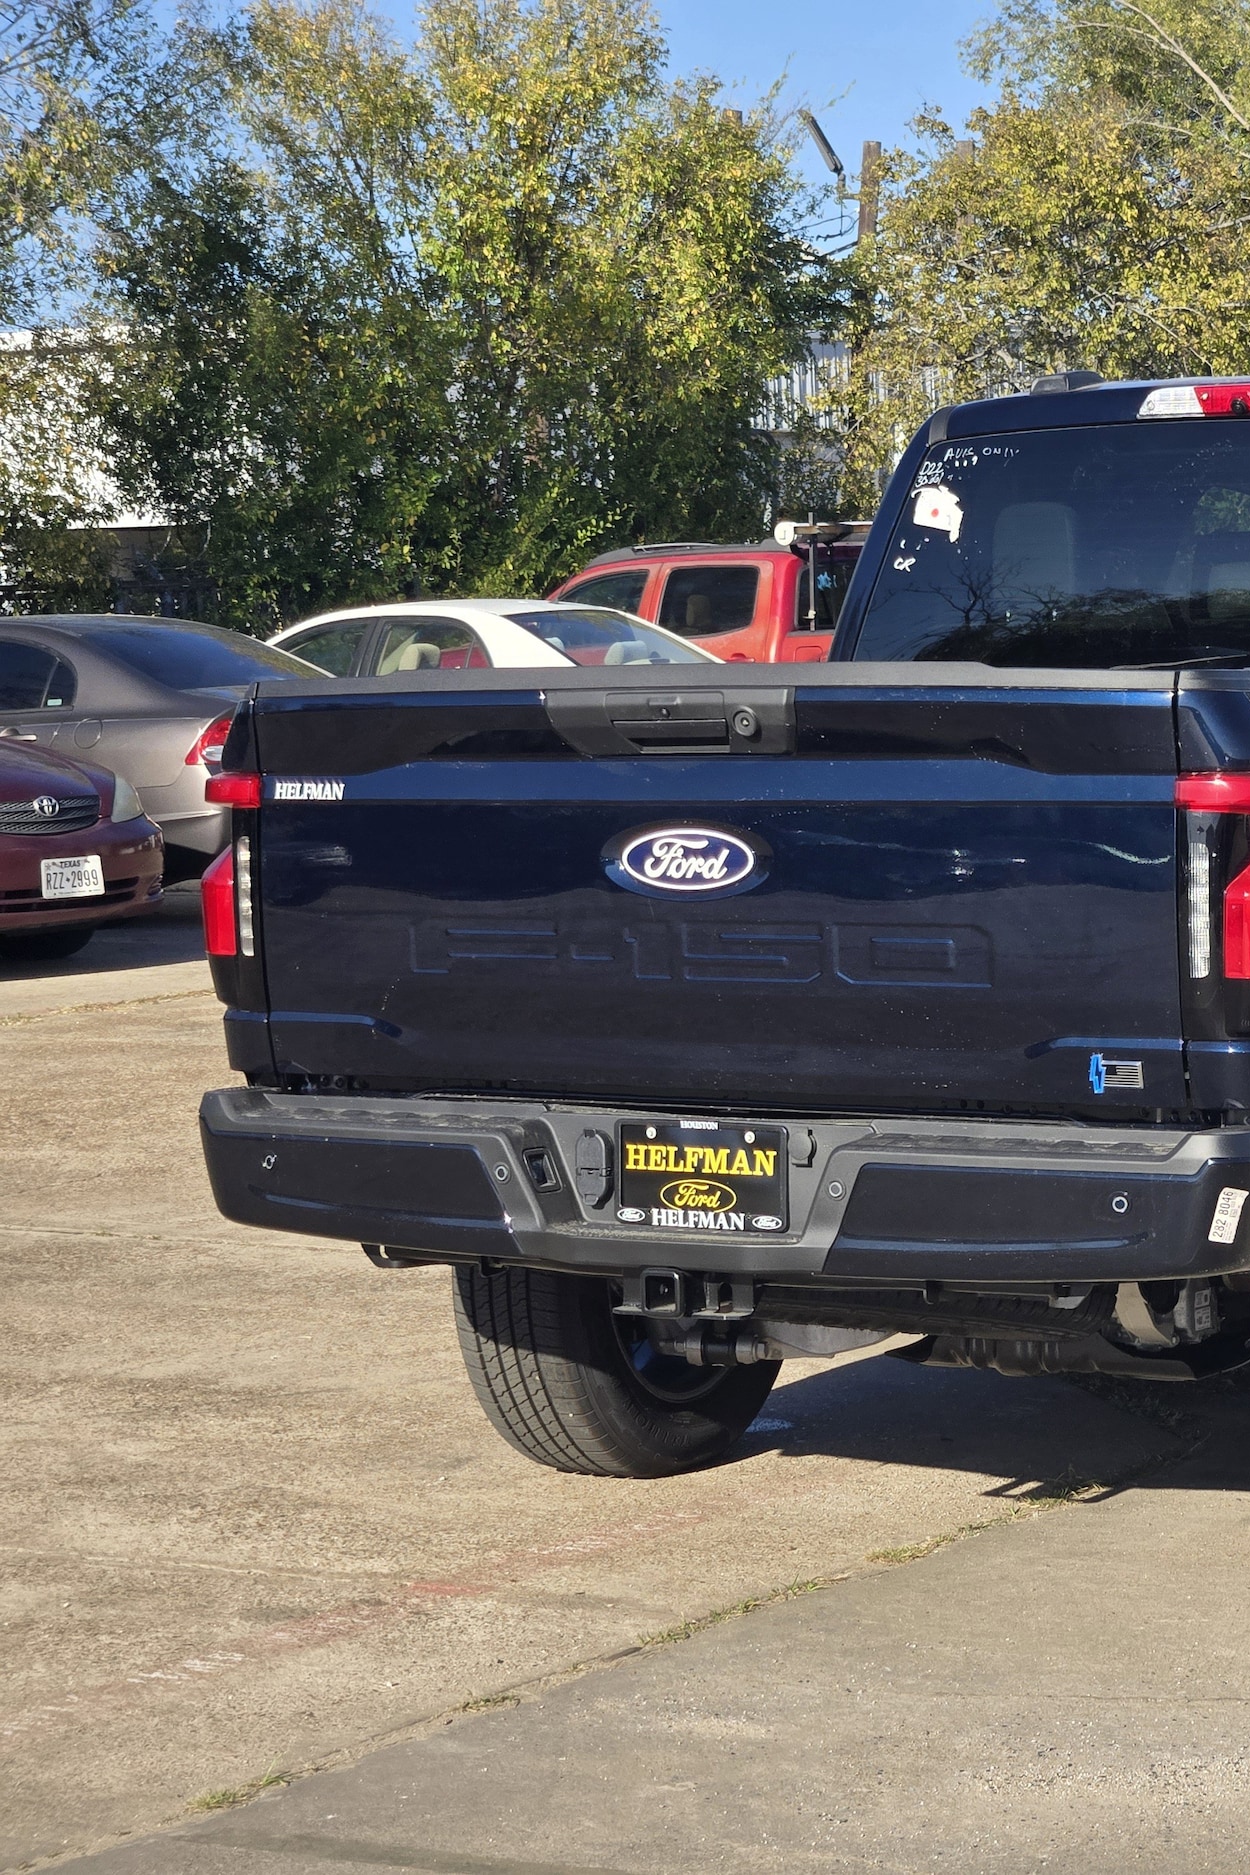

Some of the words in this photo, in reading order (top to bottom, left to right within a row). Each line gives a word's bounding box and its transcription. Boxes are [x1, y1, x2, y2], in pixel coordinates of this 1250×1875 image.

[274, 782, 345, 800] HELFMAN
[60, 860, 81, 869] TEXAS
[643, 837, 729, 881] Ford
[410, 917, 994, 988] F-150
[680, 1120, 719, 1130] HOUSTON
[625, 1144, 777, 1176] HELFMAN
[674, 1182, 721, 1208] Ford
[1218, 1191, 1234, 1216] 8046
[651, 1208, 746, 1231] HELFMAN
[1212, 1218, 1227, 1238] 282
